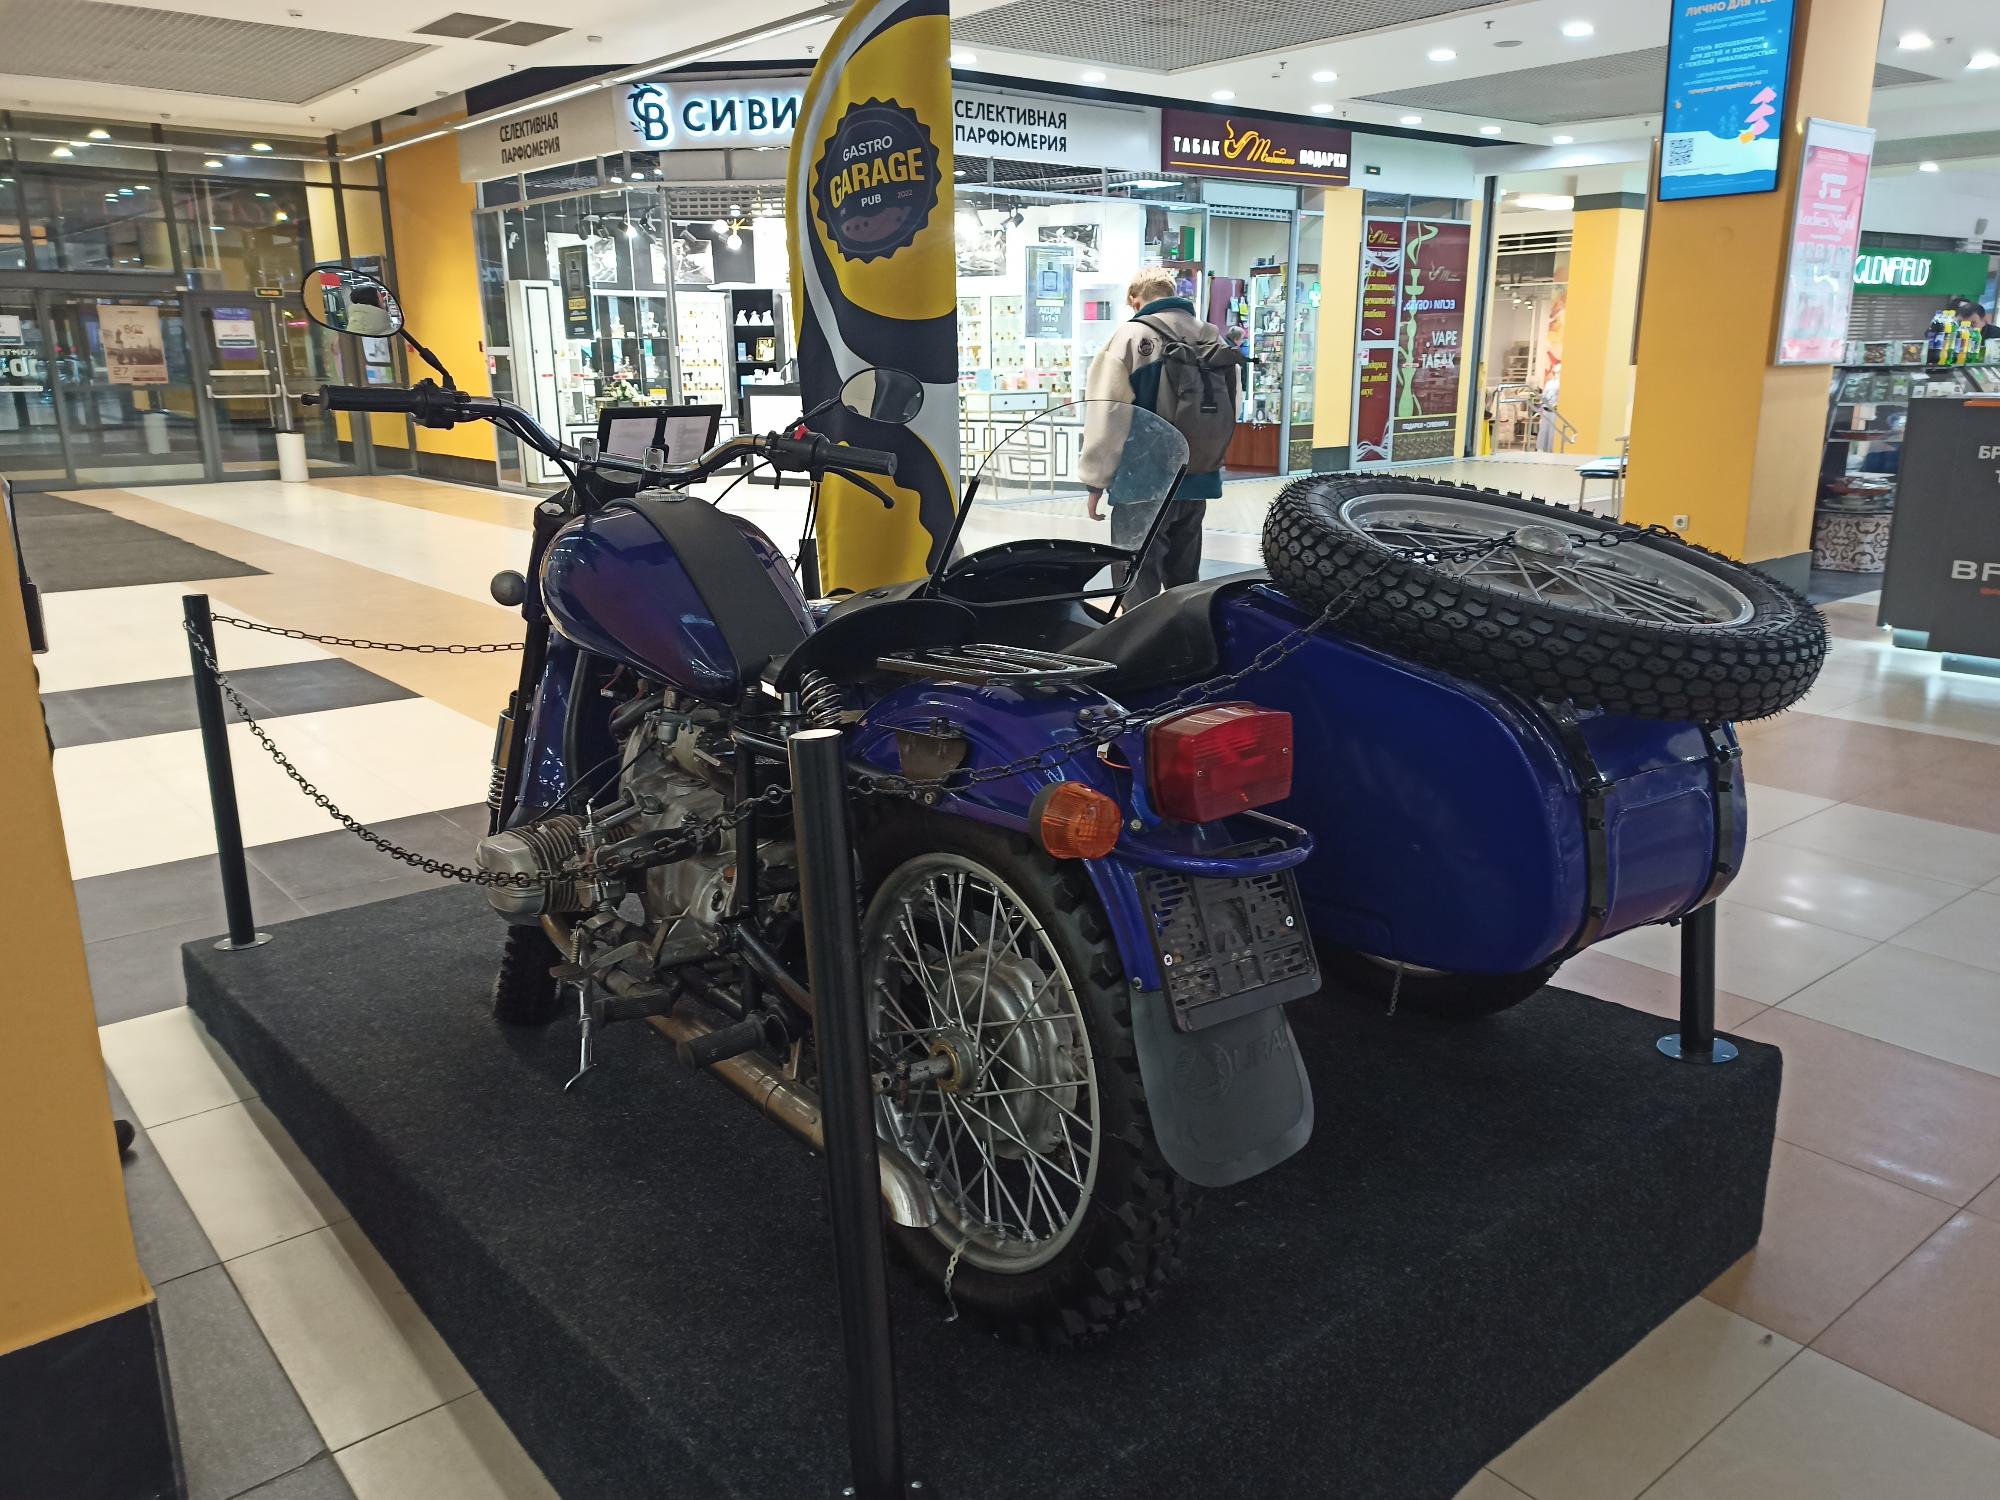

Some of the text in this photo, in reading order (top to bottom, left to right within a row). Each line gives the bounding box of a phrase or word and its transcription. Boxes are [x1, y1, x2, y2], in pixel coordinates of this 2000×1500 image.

[1685, 1, 1726, 17] ЛИЧНО
[499, 111, 560, 143] СЕЛЕКТИВНАЯ
[954, 99, 1067, 130] СЕЛЕКТИВНАЯ
[501, 136, 561, 165] ПАРФЮМЕРИЯ
[842, 135, 893, 162] GASTRO
[955, 124, 1067, 153] ПАРФЮМЕРИЯ
[1173, 136, 1221, 156] ТАБАК
[1299, 149, 1348, 169] ПОДАРКИ
[829, 147, 925, 208] GARAGE
[861, 193, 882, 207] PUB
[1431, 330, 1458, 346] VAPE
